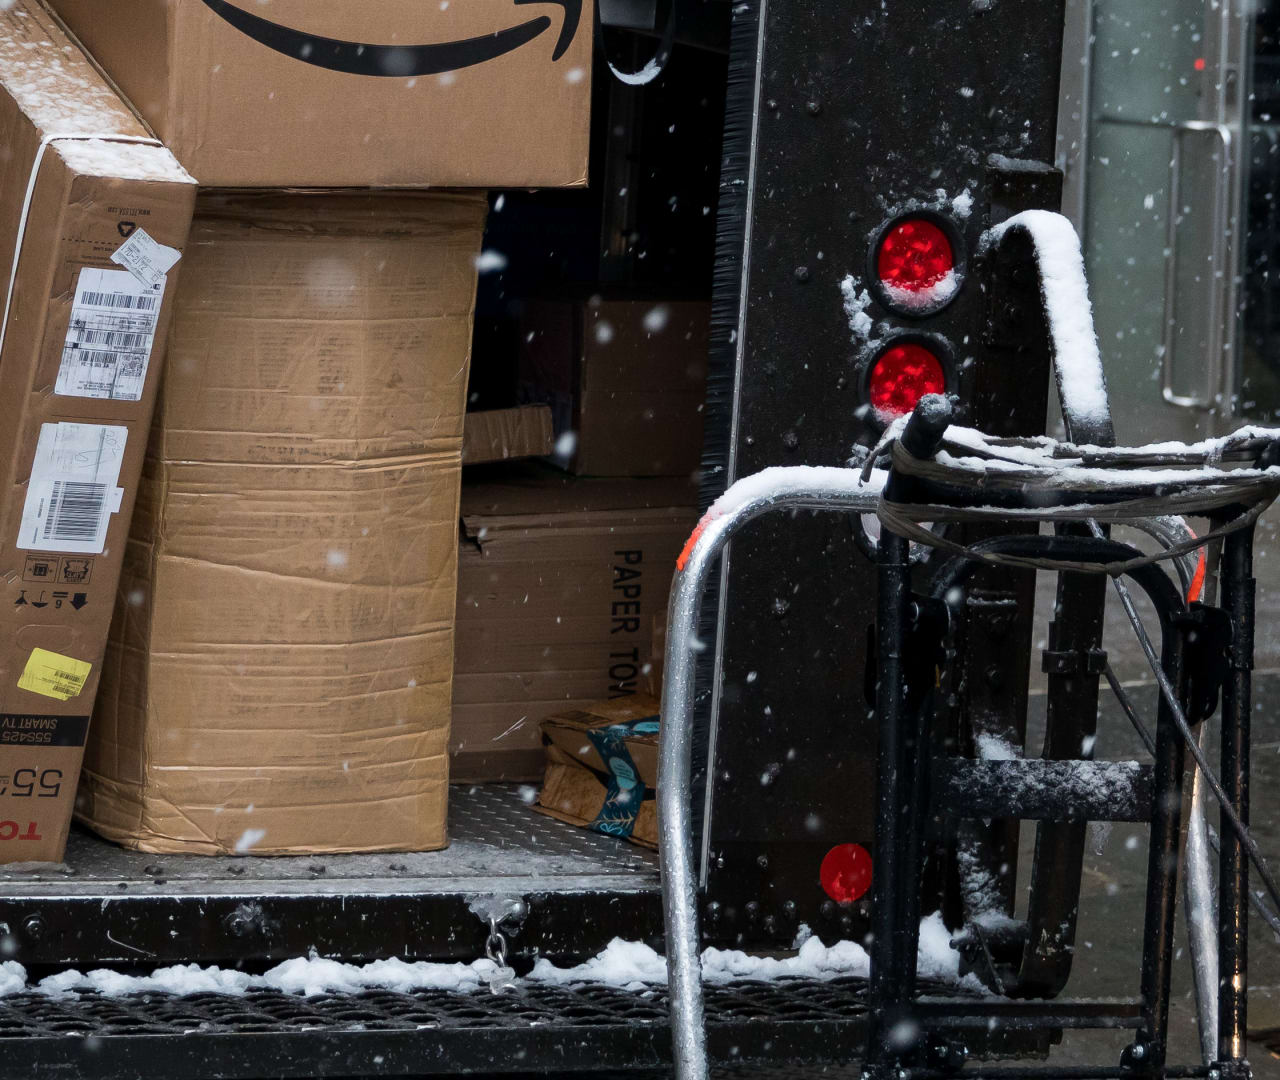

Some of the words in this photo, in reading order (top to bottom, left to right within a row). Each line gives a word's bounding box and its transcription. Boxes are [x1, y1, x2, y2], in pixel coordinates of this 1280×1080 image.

[610, 549, 643, 635] PAPER
[1, 717, 18, 729] TV
[17, 718, 58, 730] SMART
